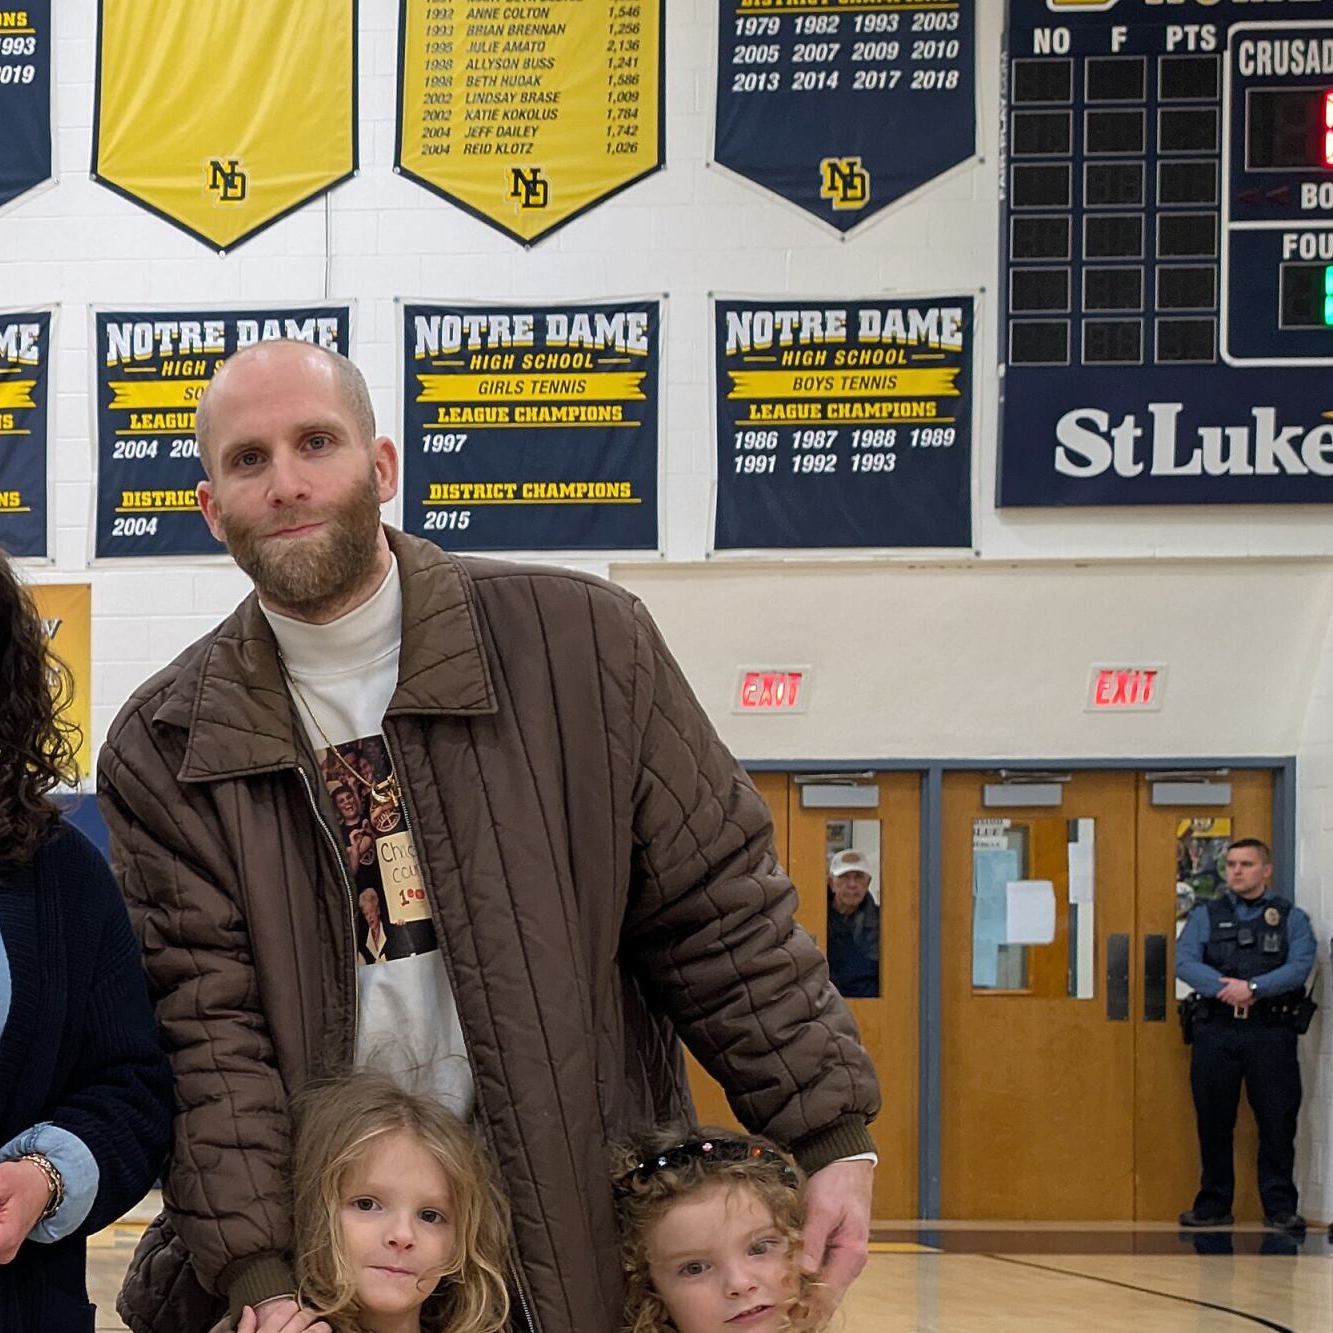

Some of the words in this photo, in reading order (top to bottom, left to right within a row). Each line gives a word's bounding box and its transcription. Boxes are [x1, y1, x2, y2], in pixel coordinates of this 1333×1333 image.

[735, 16, 780, 37] 1979
[794, 15, 839, 36] 1982
[853, 14, 899, 34] 1993
[911, 13, 959, 33] 2003
[1033, 28, 1070, 54] NO
[1111, 28, 1127, 52] F
[1166, 25, 1216, 51] PTS
[421, 143, 450, 155] 2004
[464, 143, 492, 155] REID
[496, 142, 534, 154] KLOTZ
[606, 142, 638, 155] 1,026
[726, 311, 847, 355] NOTRE
[859, 308, 963, 353] DAME
[478, 378, 525, 395] GIRLS
[528, 378, 586, 394] TENNIS
[792, 374, 837, 391] BOYS
[840, 374, 897, 391] TENNIS
[749, 403, 822, 421] LEAGUE
[827, 402, 937, 419] CHAMPIONS
[421, 434, 467, 453] 1997
[734, 431, 778, 450] 1986
[791, 430, 838, 449] 1987
[850, 430, 896, 449] 1988
[909, 428, 955, 448] 1989
[430, 482, 519, 500] DISTRICT
[524, 481, 631, 499] CHAMPIONS
[423, 511, 470, 530] 2015
[741, 672, 802, 708] EXIT
[1095, 670, 1158, 705] EXIT
